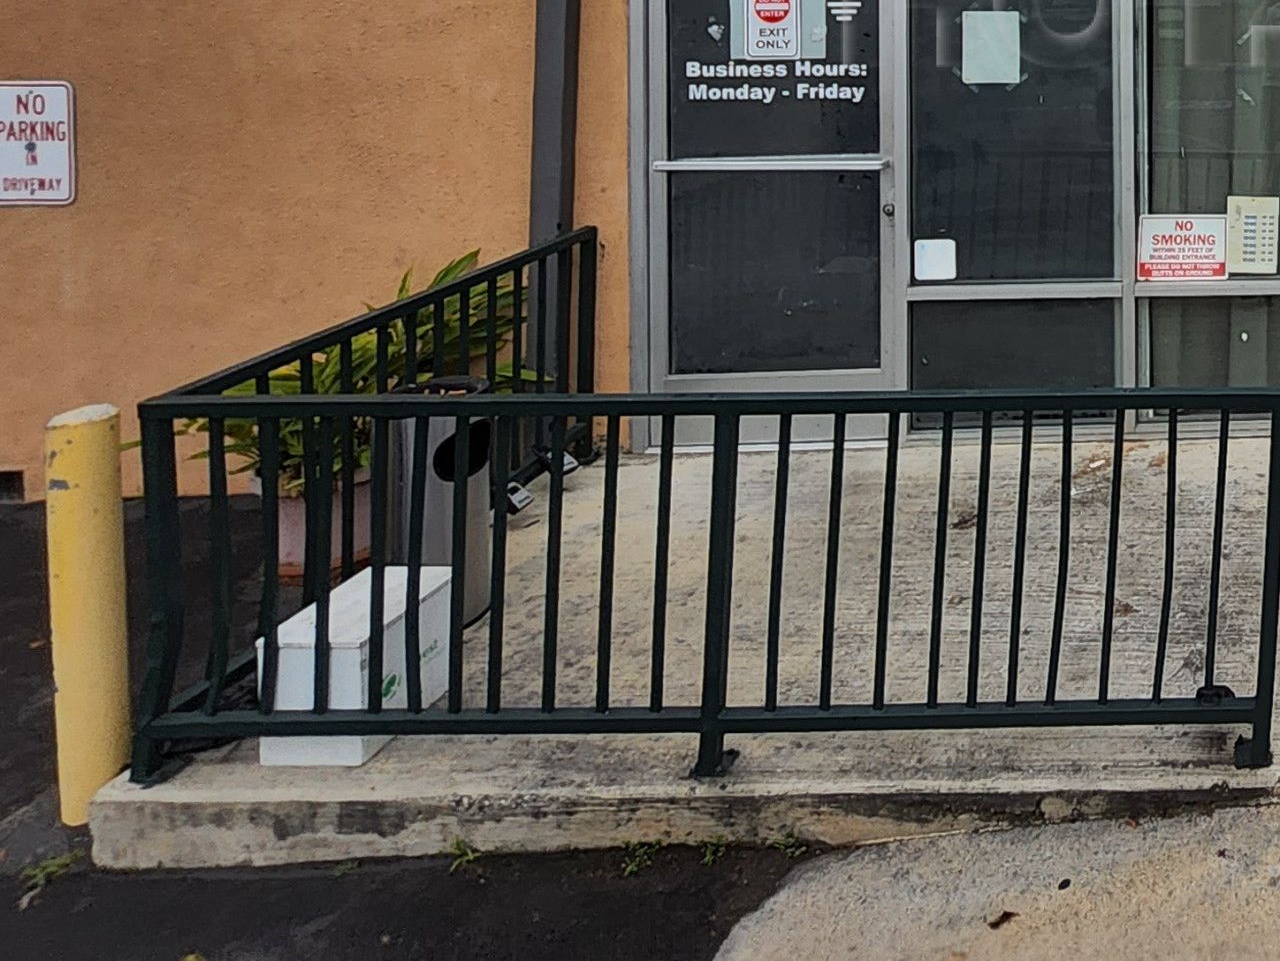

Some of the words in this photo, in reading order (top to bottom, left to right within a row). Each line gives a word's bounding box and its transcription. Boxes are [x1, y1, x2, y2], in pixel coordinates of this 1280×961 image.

[759, 28, 788, 37] EXIT
[756, 40, 791, 49] ONLY
[685, 61, 788, 78] Business
[795, 60, 867, 77] Hours:
[688, 84, 776, 104] Monday
[796, 83, 865, 103] Friday
[16, 94, 45, 115] NO
[0, 121, 66, 141] PARKING
[3, 177, 62, 191] DRIVEWAY
[1174, 220, 1193, 231] NO
[1152, 234, 1216, 246] SMOKING
